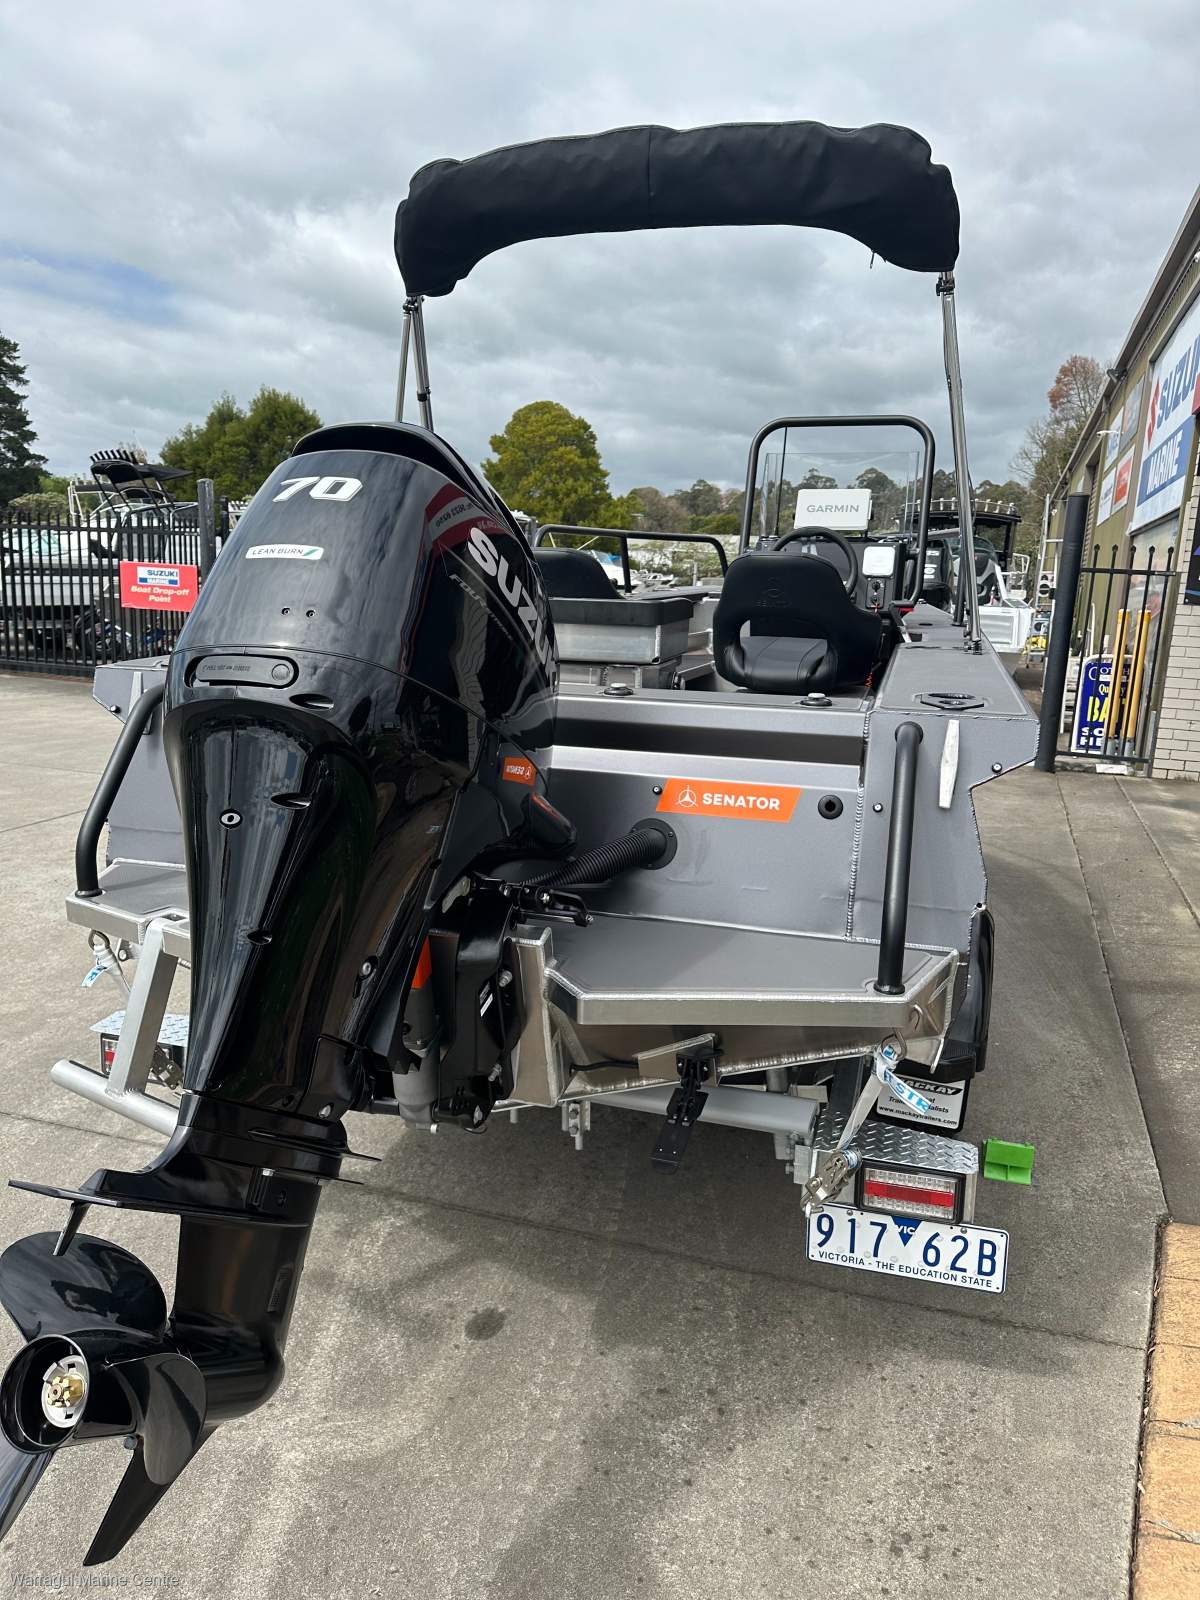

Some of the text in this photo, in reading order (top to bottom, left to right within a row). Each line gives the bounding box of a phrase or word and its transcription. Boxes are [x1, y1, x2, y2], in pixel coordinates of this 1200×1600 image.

[1146, 429, 1184, 496] MARINE
[272, 476, 364, 502] 70
[806, 504, 860, 513] GARMIN
[252, 548, 304, 556] LEAN BURN
[147, 569, 178, 577] SUZUKI
[131, 585, 190, 596] Boat Drop-off
[149, 595, 171, 603] Point
[702, 792, 780, 811] SENATOR
[902, 1079, 956, 1095] ACKAY
[879, 1106, 957, 1125] www.mackaytrailers.com
[896, 1226, 916, 1235] VIC
[816, 1213, 998, 1277] 917 62B
[818, 1250, 865, 1266] VICTORIA
[876, 1260, 895, 1271] THE
[898, 1264, 958, 1282] EDUCATION
[961, 1275, 993, 1288] STATE
